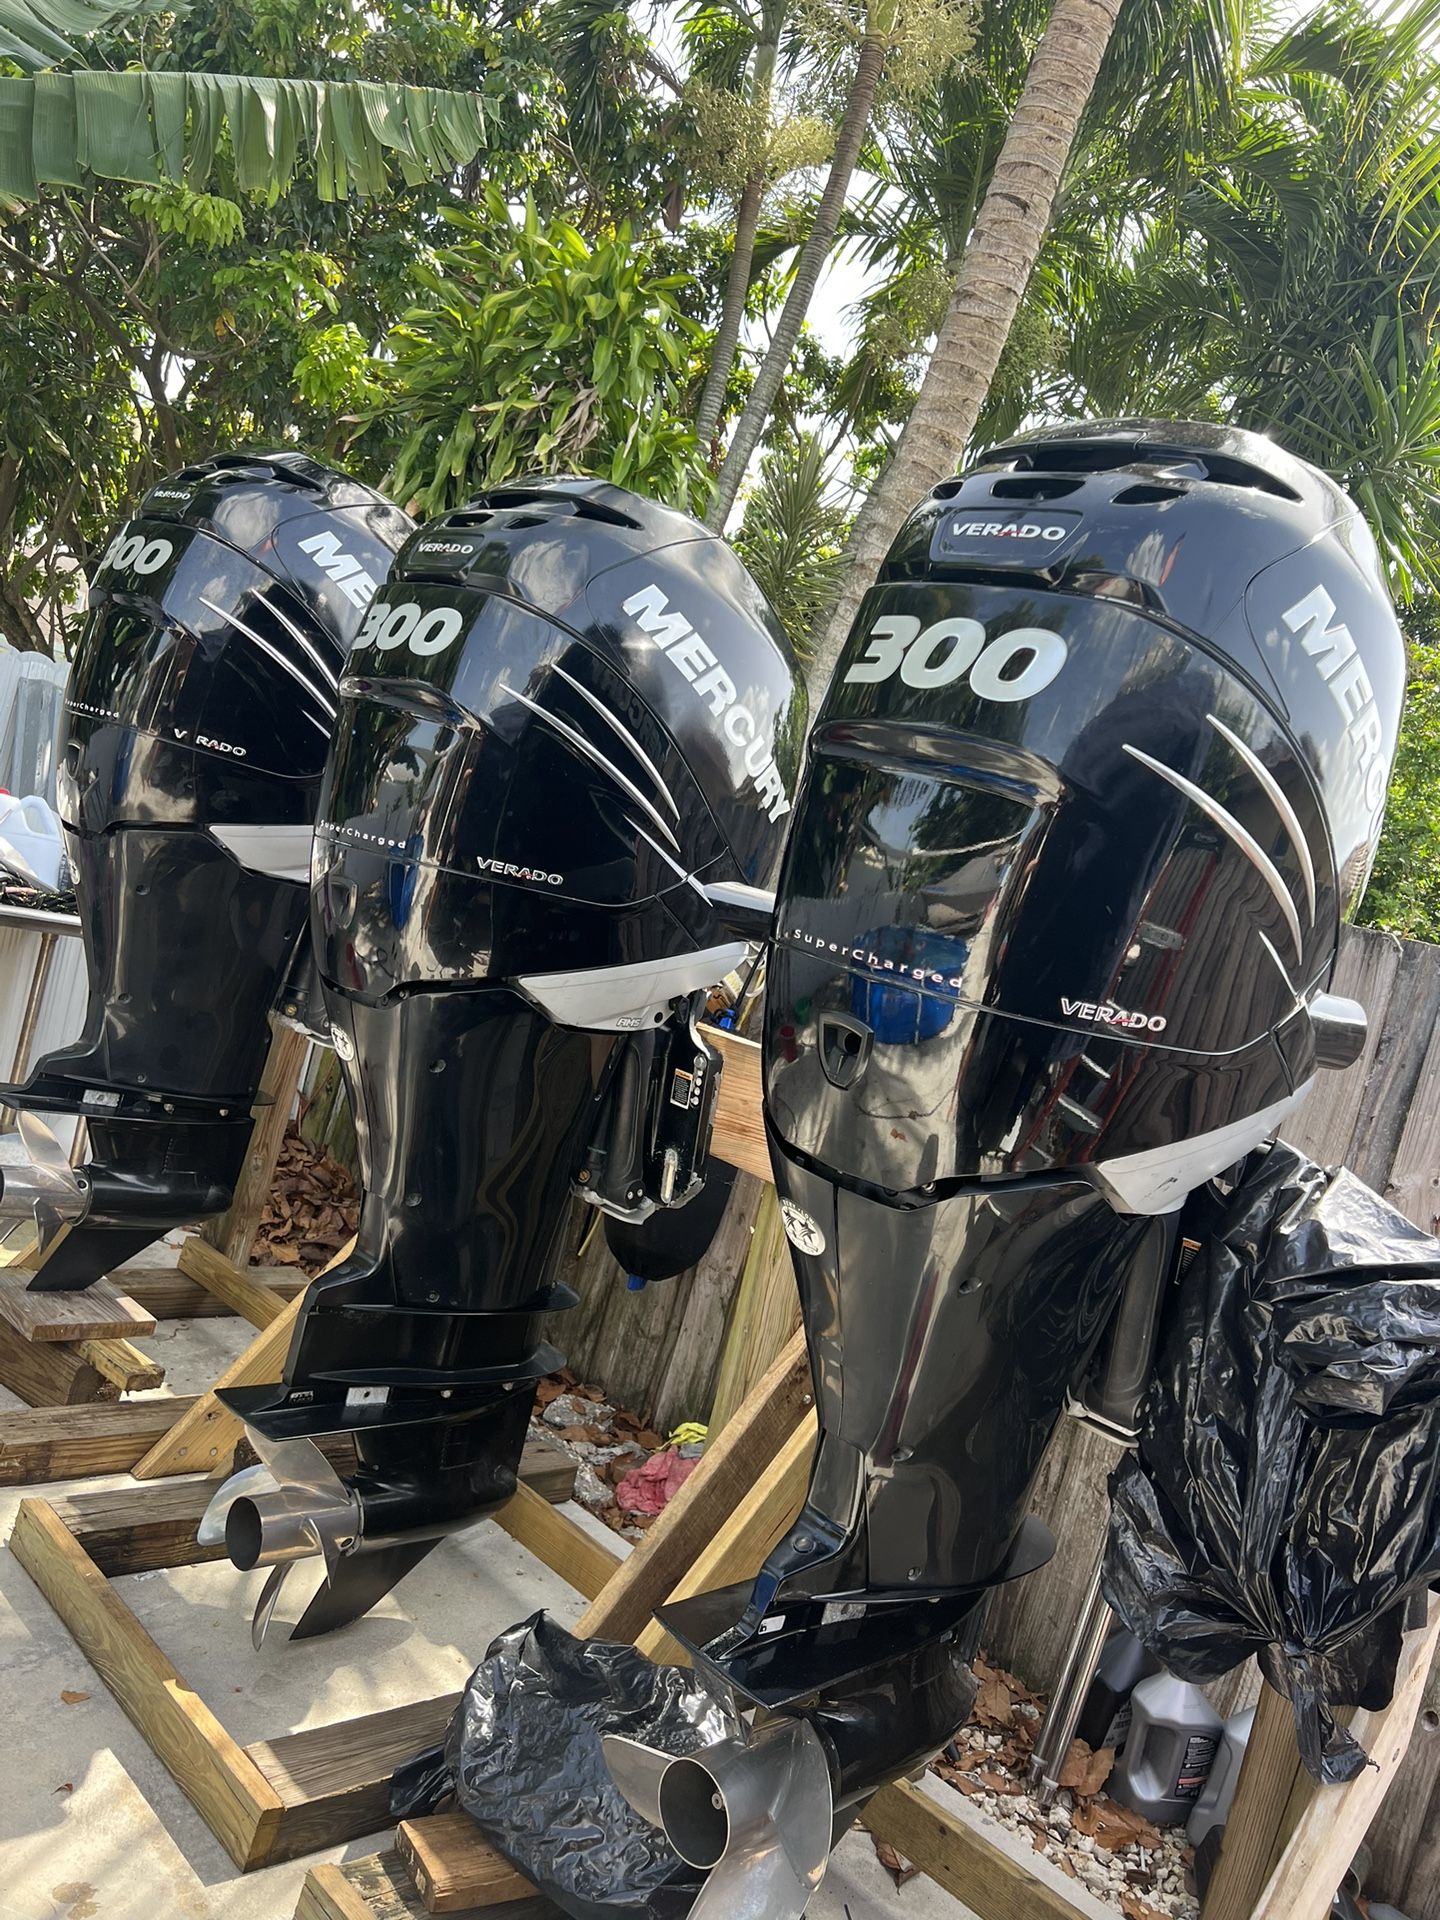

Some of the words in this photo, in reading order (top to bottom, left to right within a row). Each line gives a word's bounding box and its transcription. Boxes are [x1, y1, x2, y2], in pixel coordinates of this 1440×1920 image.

[418, 543, 474, 554] VERADO
[953, 522, 1067, 541] VERADO
[297, 530, 379, 616] ME
[351, 602, 463, 656] 300
[843, 615, 1069, 703] 300
[622, 583, 791, 824] MERCURY
[320, 819, 406, 850] SuperCharged
[476, 856, 564, 886] VERADO
[793, 929, 963, 989] SuperCharged
[1060, 997, 1168, 1032] VERADO
